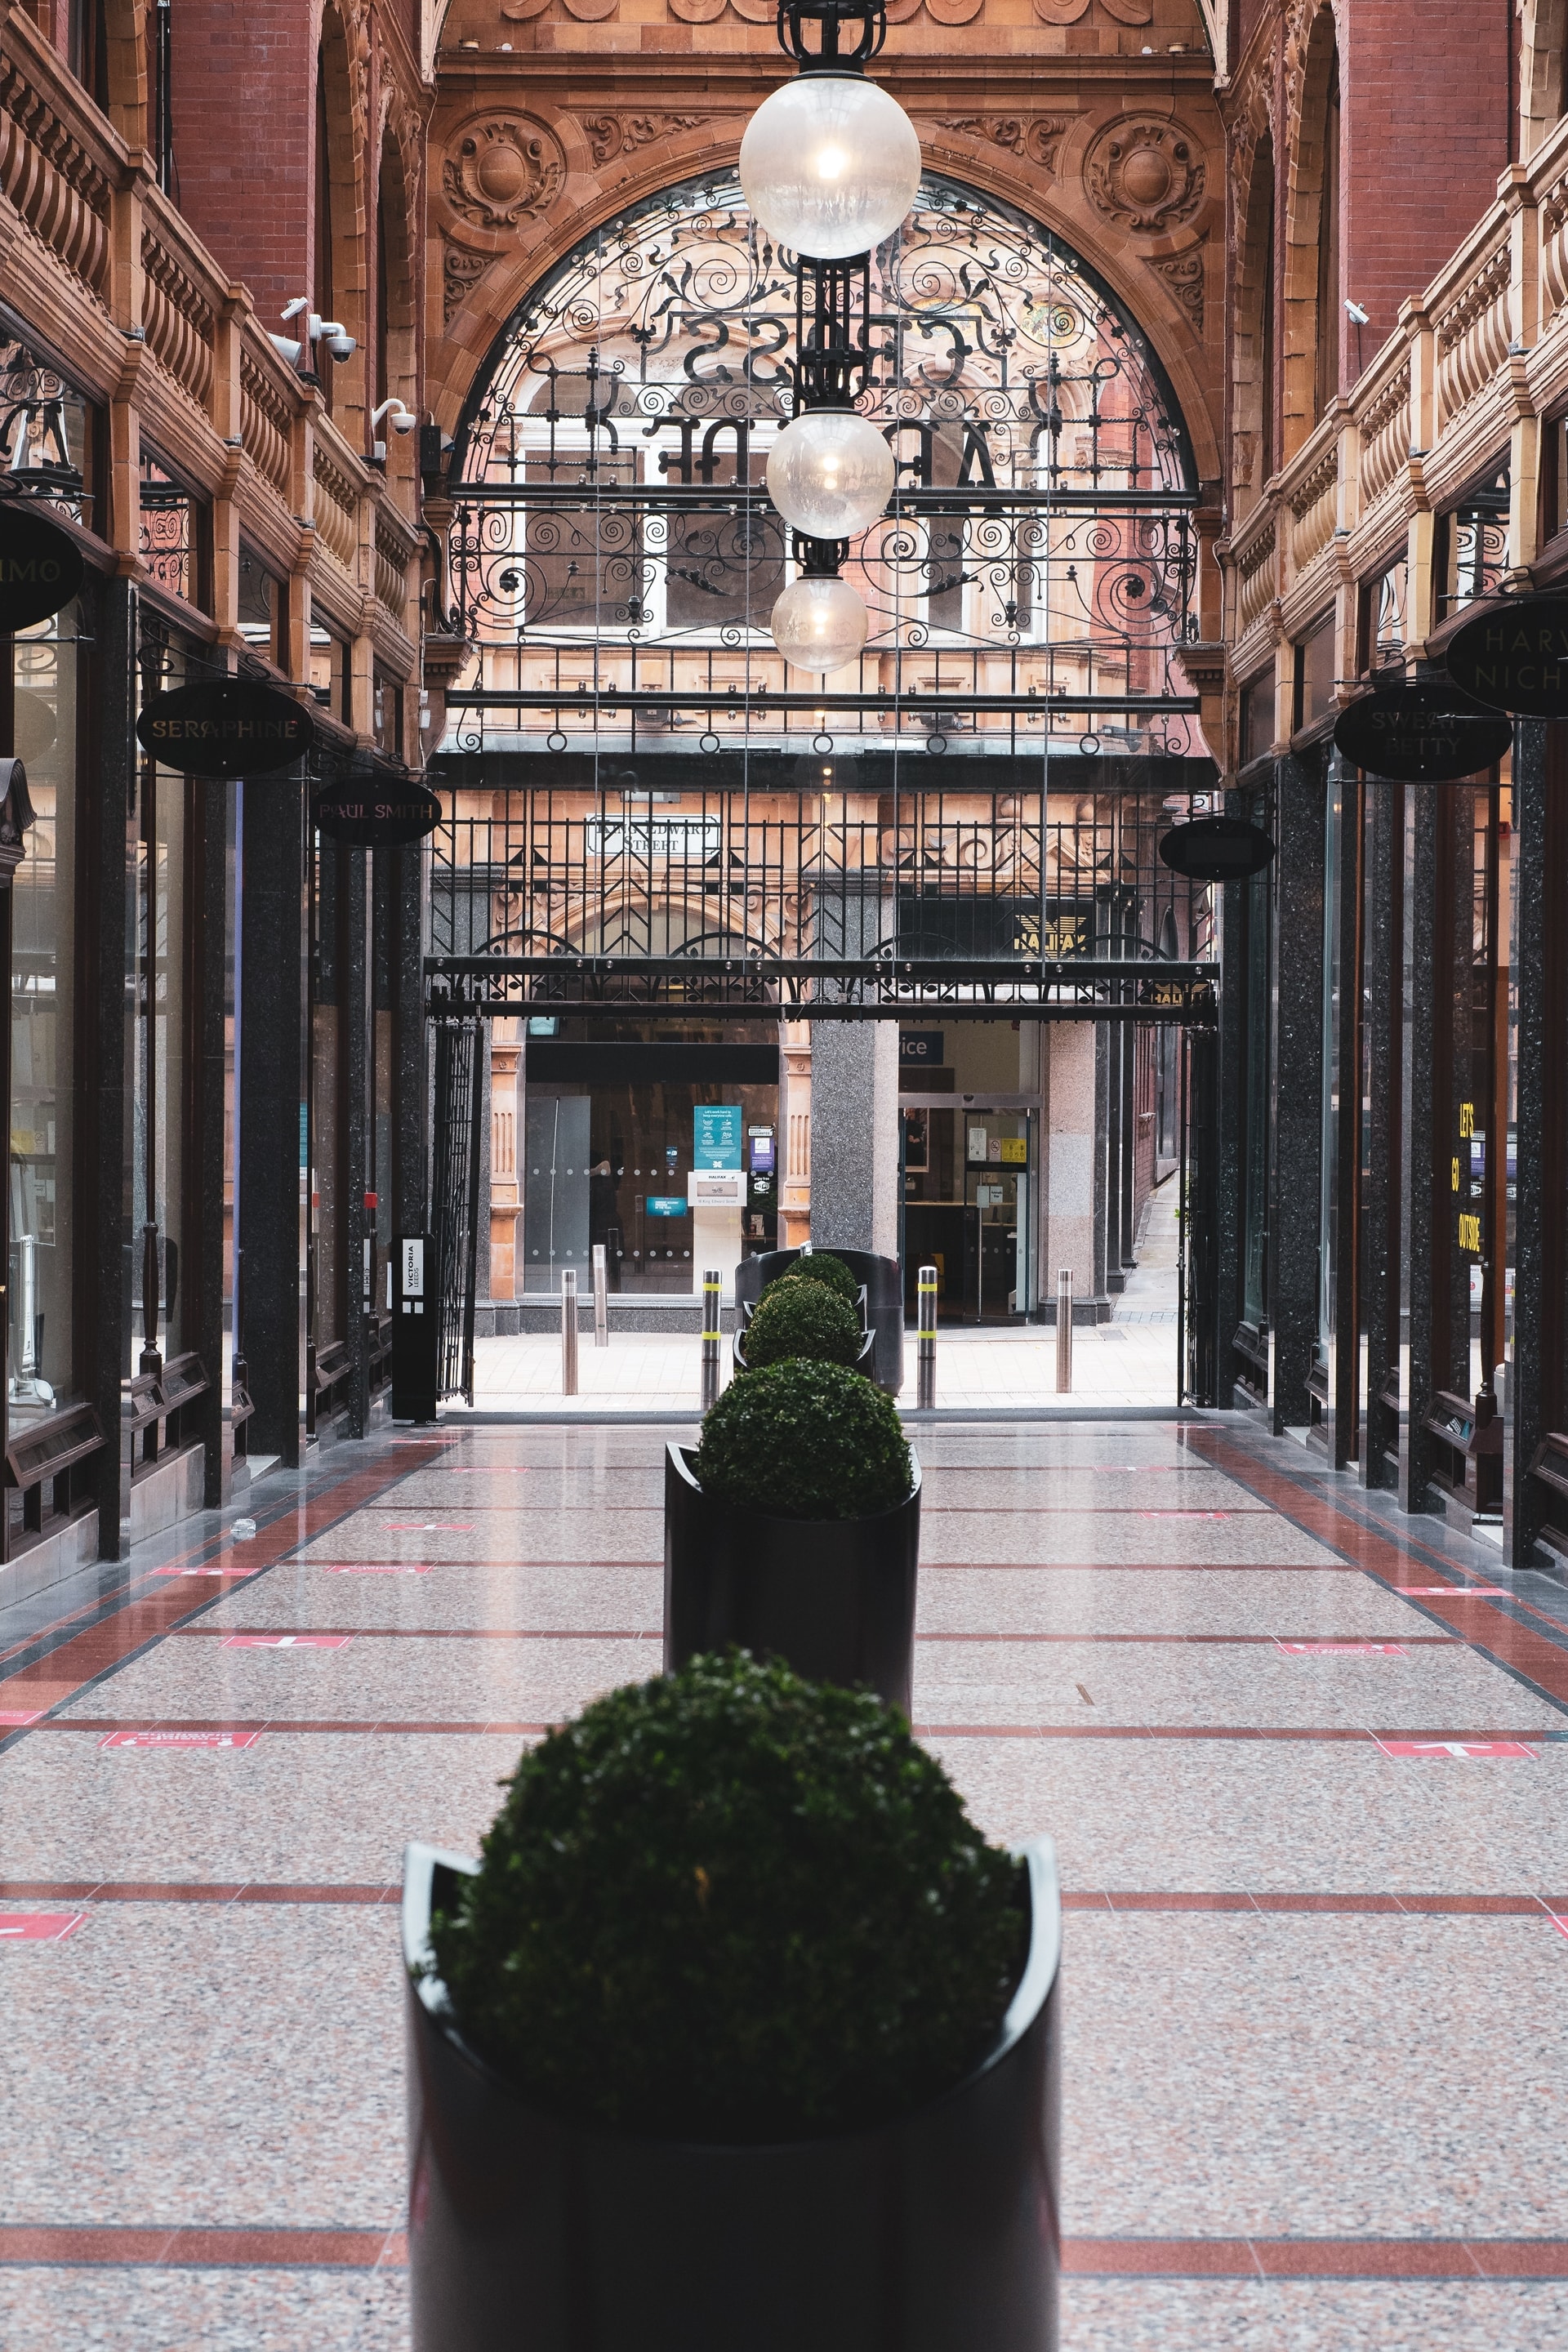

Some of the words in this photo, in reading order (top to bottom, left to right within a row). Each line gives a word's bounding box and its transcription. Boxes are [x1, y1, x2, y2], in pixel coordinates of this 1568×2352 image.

[153, 719, 297, 739] SERAPHINE
[1371, 712, 1477, 730] SWEATY
[1386, 738, 1463, 755] BETTY
[318, 803, 368, 820] PAUL
[374, 803, 434, 820] SMITH
[623, 835, 679, 851] STREET
[898, 1036, 928, 1055] ice
[1459, 1102, 1475, 1138] LET'S
[1459, 1213, 1481, 1253] OUTSIDE
